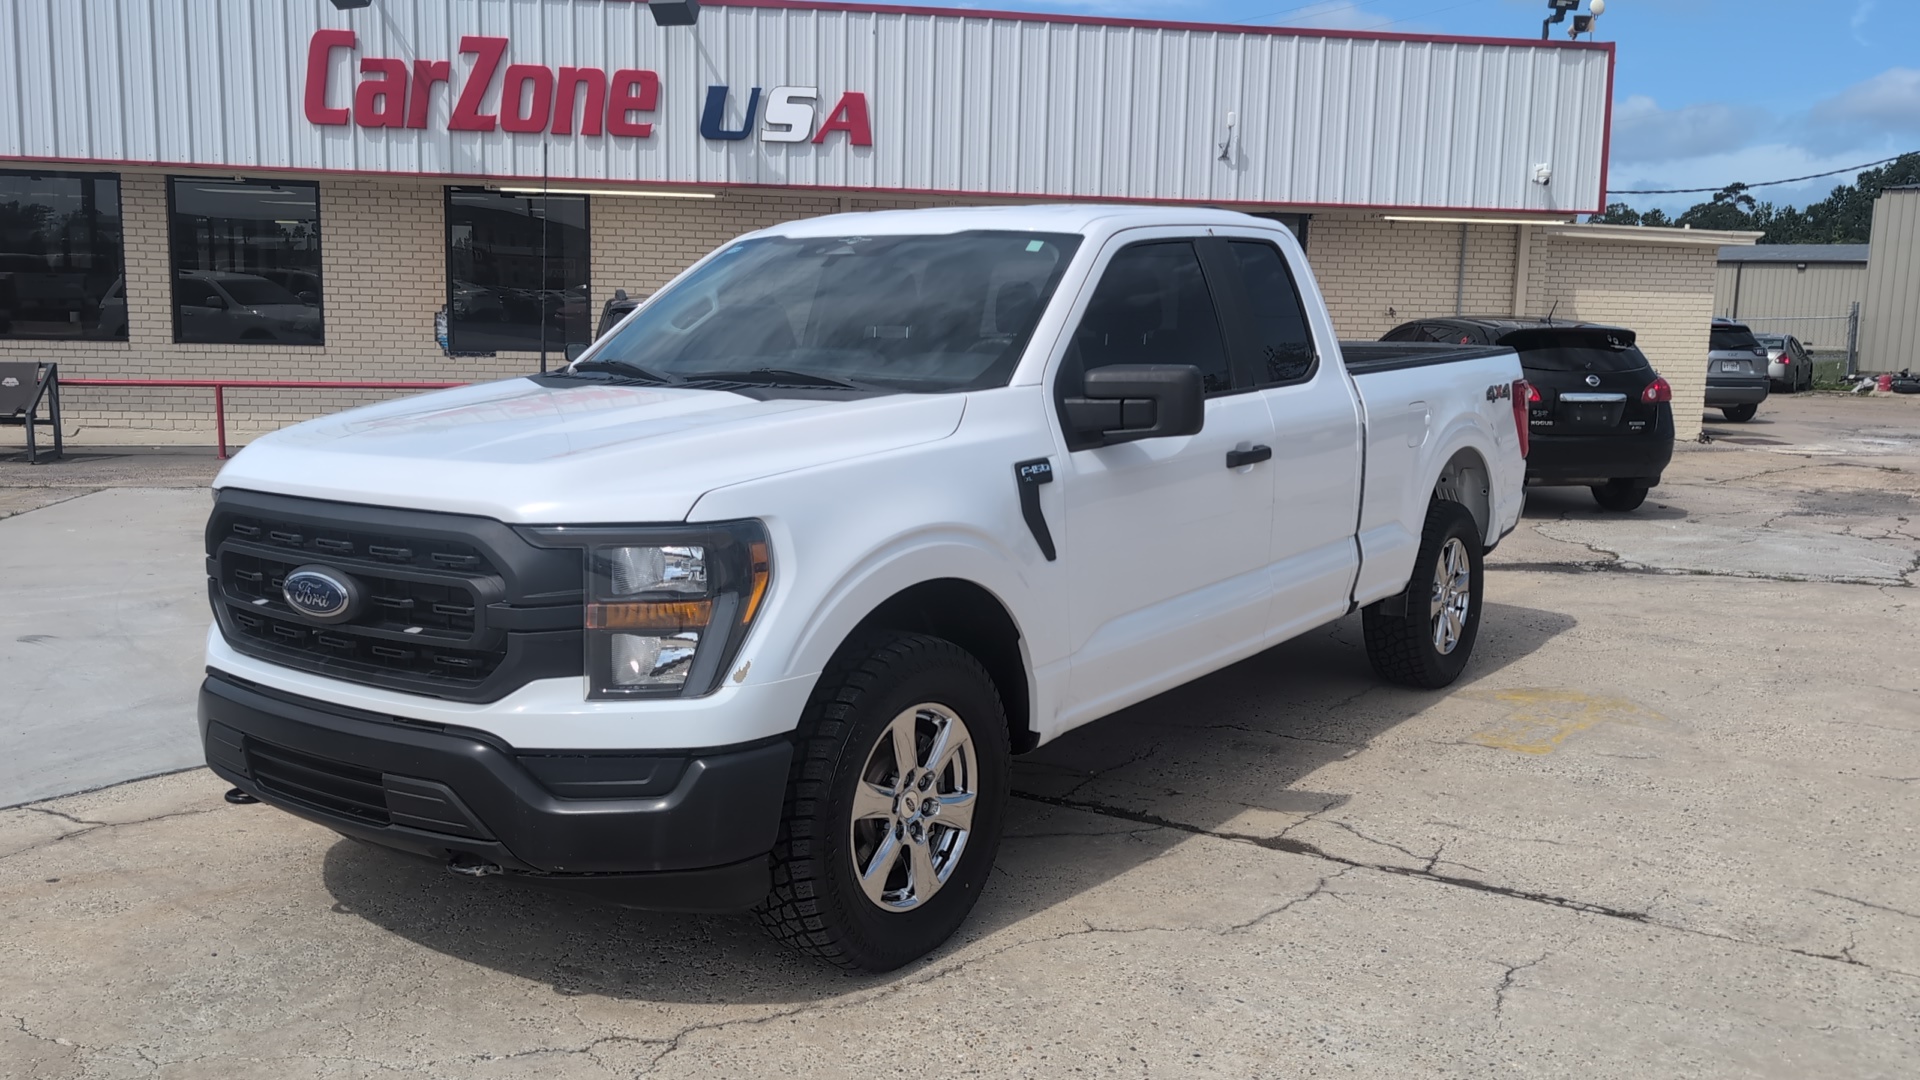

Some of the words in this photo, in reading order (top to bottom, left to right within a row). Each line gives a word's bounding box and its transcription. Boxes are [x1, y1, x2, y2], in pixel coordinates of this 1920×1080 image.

[304, 29, 659, 138] CarZone
[699, 84, 872, 146] USA
[1021, 463, 1050, 476] F-150
[296, 581, 330, 607] Ford
